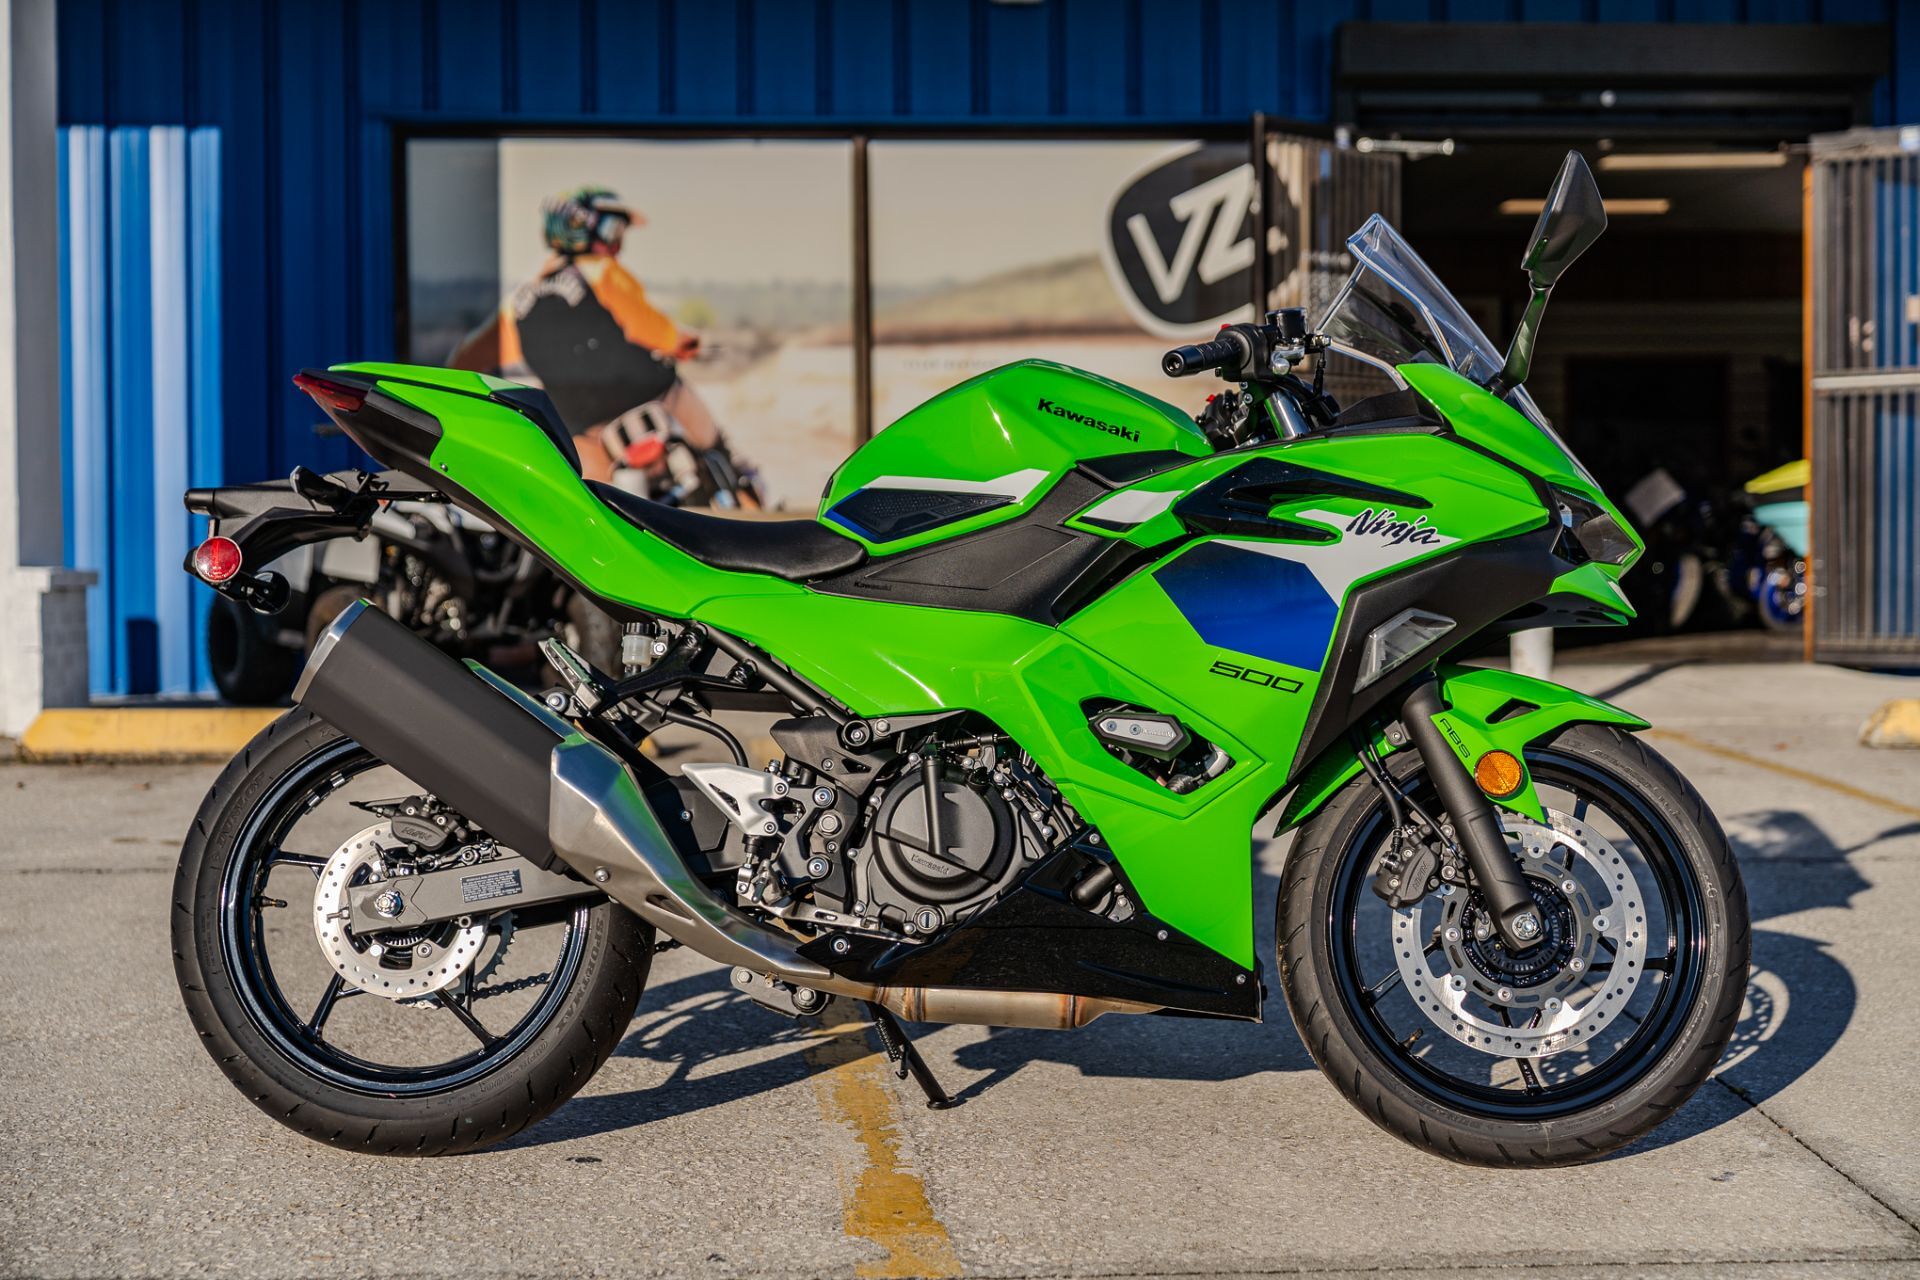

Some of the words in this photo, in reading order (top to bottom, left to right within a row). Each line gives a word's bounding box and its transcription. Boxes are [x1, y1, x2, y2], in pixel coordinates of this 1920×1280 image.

[1037, 397, 1140, 443] Kawasaki
[1345, 508, 1441, 549] Ninja
[1209, 660, 1304, 694] 500
[1439, 718, 1471, 758] ABS
